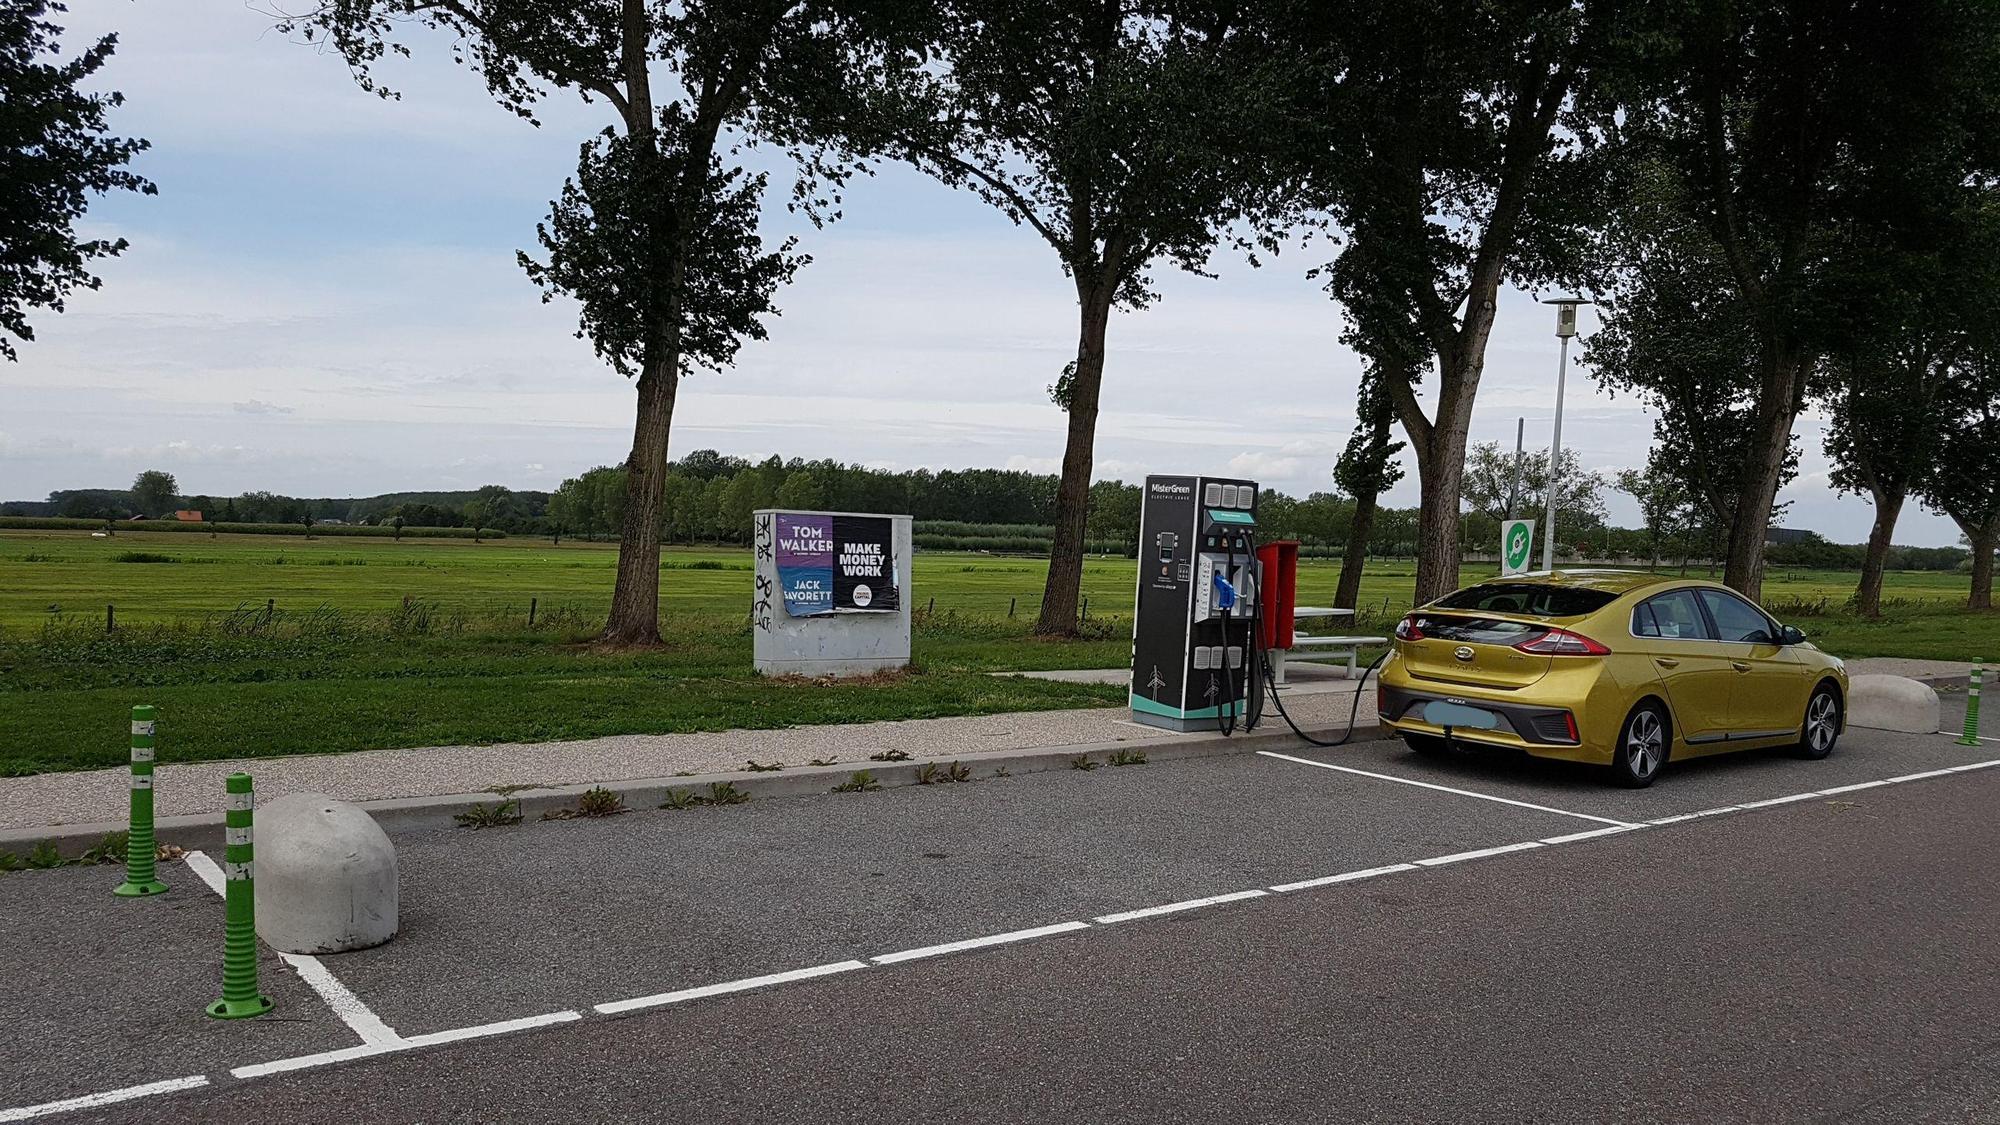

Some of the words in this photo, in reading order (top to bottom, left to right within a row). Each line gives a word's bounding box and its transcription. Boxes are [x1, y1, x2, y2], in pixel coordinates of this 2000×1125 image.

[1152, 483, 1190, 494] MisterGreen
[792, 526, 822, 539] TOM
[780, 539, 833, 552] WALKER
[844, 543, 881, 554] MAKE
[839, 554, 886, 566] MONEY
[842, 565, 882, 577] WORK
[794, 580, 820, 590] JACK
